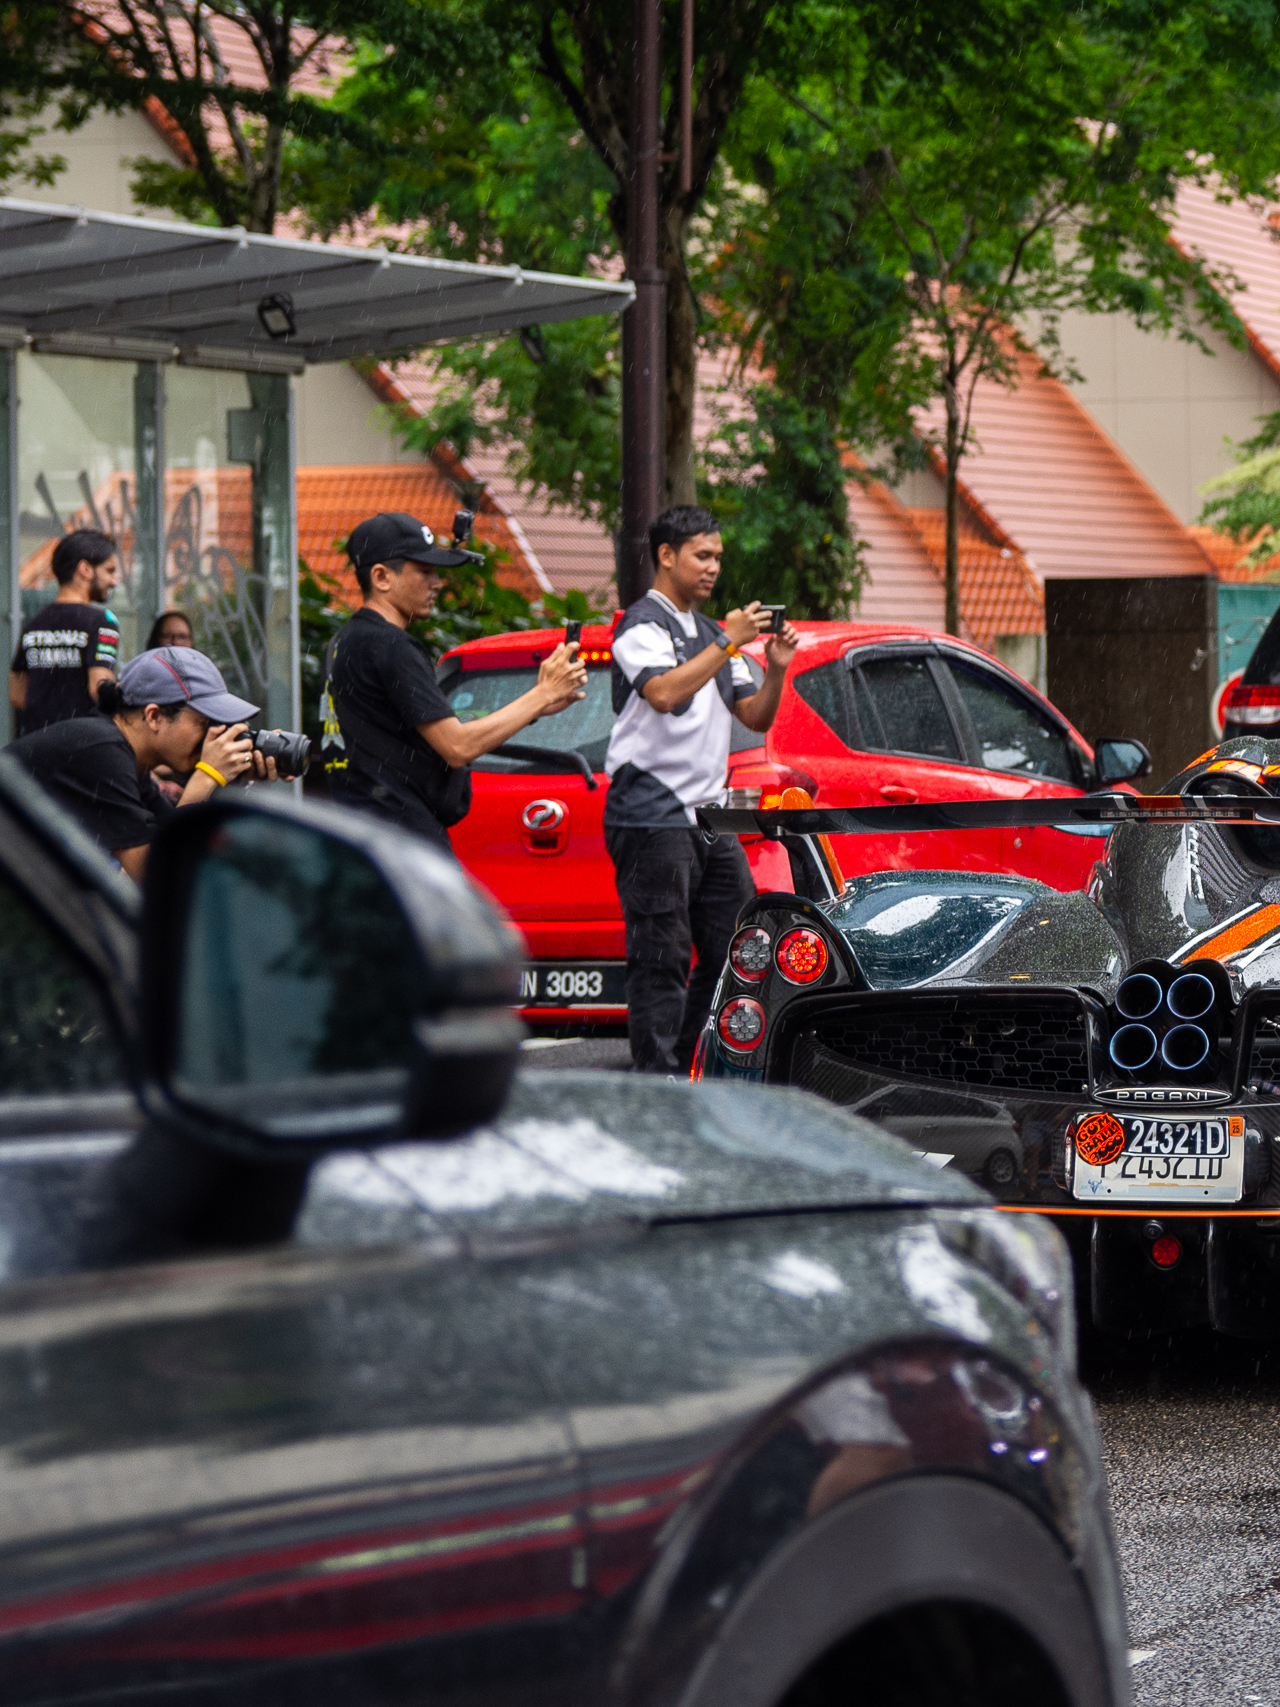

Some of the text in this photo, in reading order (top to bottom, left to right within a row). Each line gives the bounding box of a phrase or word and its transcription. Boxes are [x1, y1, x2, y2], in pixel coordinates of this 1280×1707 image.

[546, 970, 603, 998] 3083
[1117, 1091, 1208, 1101] PAGANI
[1128, 1119, 1225, 1155] 24321D
